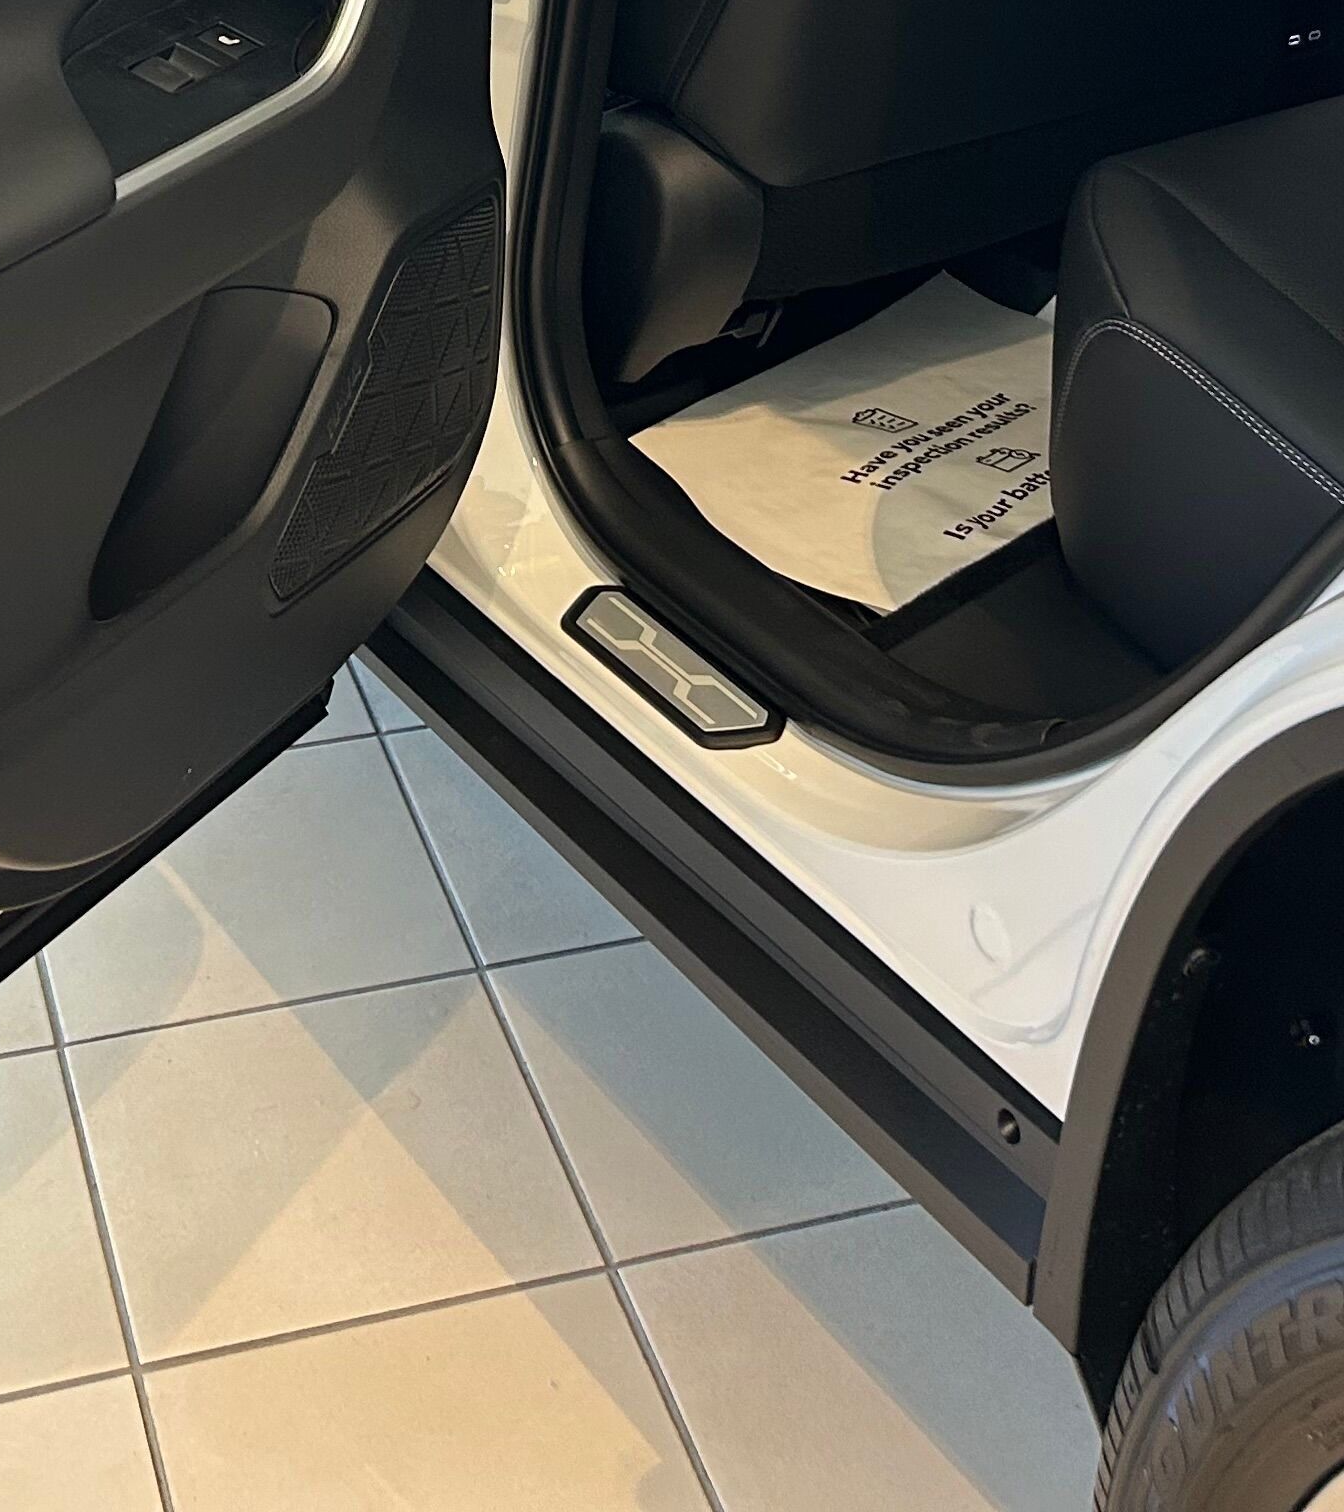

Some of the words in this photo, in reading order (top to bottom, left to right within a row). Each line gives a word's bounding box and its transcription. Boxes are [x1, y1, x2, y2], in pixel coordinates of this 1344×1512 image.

[840, 451, 897, 484] Have
[896, 432, 930, 454] you
[926, 414, 973, 437] seen
[965, 392, 1012, 419] your
[869, 437, 974, 491] inspection
[967, 402, 1037, 439] results?
[943, 523, 973, 540] Is
[970, 498, 1014, 530] your
